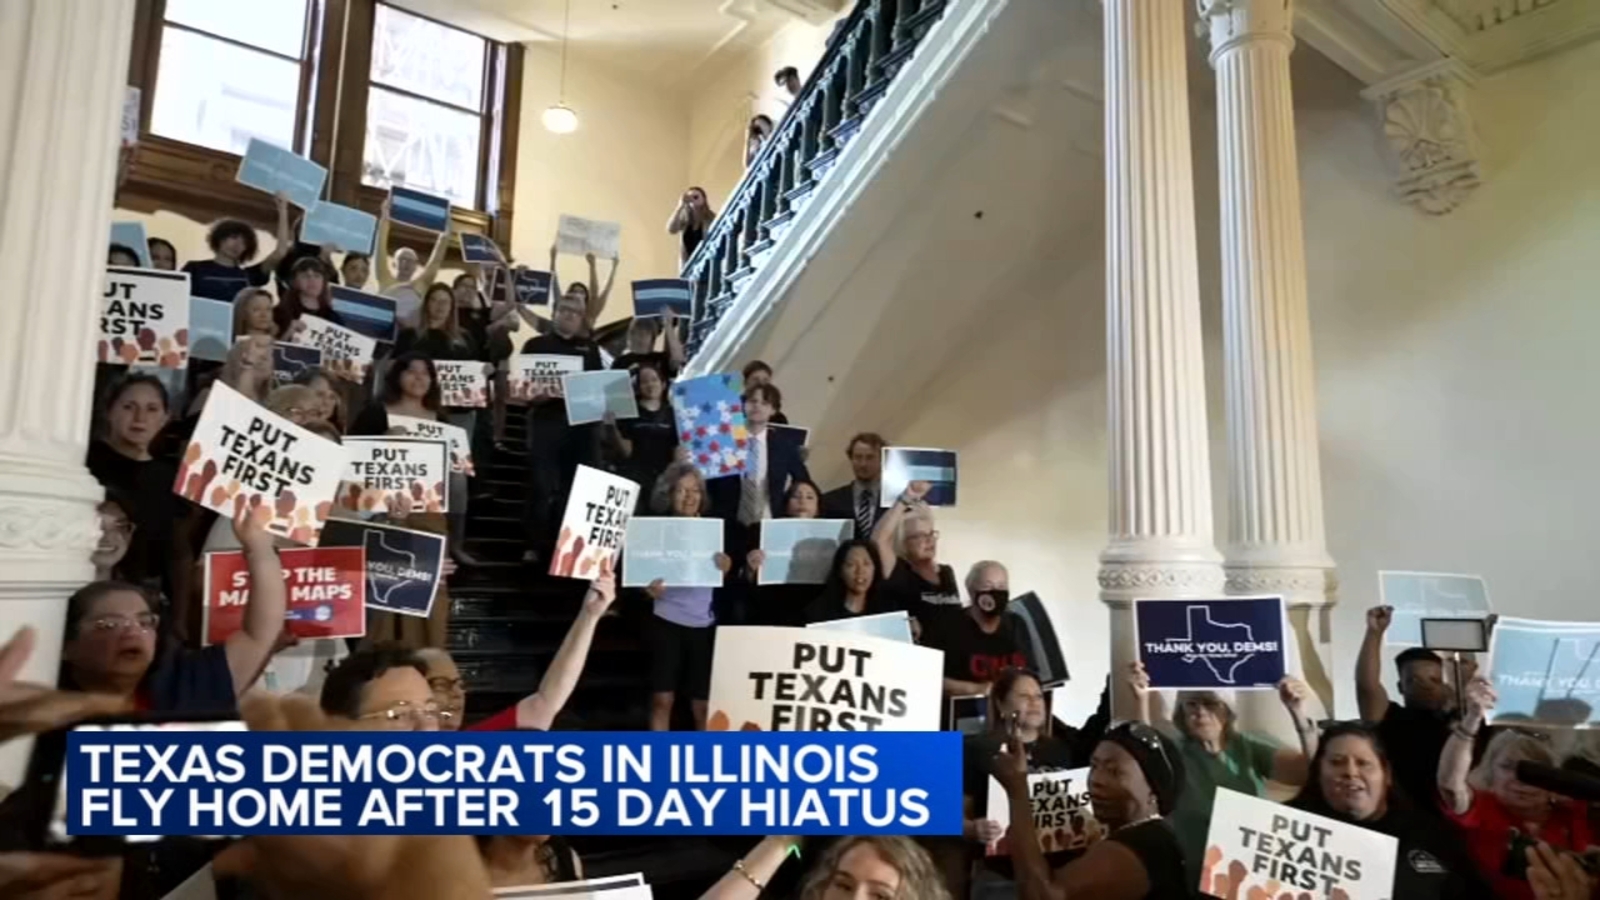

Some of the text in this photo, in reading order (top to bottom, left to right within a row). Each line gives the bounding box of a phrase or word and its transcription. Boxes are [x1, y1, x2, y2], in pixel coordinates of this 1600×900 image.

[104, 282, 137, 300] UT
[107, 300, 164, 320] ANS
[101, 317, 145, 336] RST
[325, 325, 351, 341] PUT
[310, 329, 360, 356] TEXANS
[437, 364, 461, 373] PUT
[534, 361, 559, 369] PUT
[440, 373, 475, 383] XANS
[247, 417, 299, 453] PUT
[417, 422, 444, 436] PUT
[219, 424, 316, 487] TEXANS
[371, 448, 409, 462] PUT
[222, 454, 292, 498] FIRST
[351, 462, 428, 477] TEXANS
[364, 477, 415, 491] FIRST
[605, 485, 631, 507] PUT
[585, 502, 628, 528] TEXAN
[588, 527, 623, 550] FIRS
[294, 566, 337, 583] THE
[291, 584, 354, 603] MAPS
[1145, 641, 1278, 655] THANK YOU, DEMS!
[793, 641, 872, 678] PUT
[748, 672, 908, 718] TEXANS
[771, 704, 883, 731] FIRST
[1032, 778, 1073, 797] PUT
[1031, 792, 1091, 813] EXANS
[1033, 810, 1076, 829] IRST
[1271, 814, 1333, 848] PUT
[1238, 826, 1362, 882] TEXANS
[1252, 854, 1340, 891] FIRST
